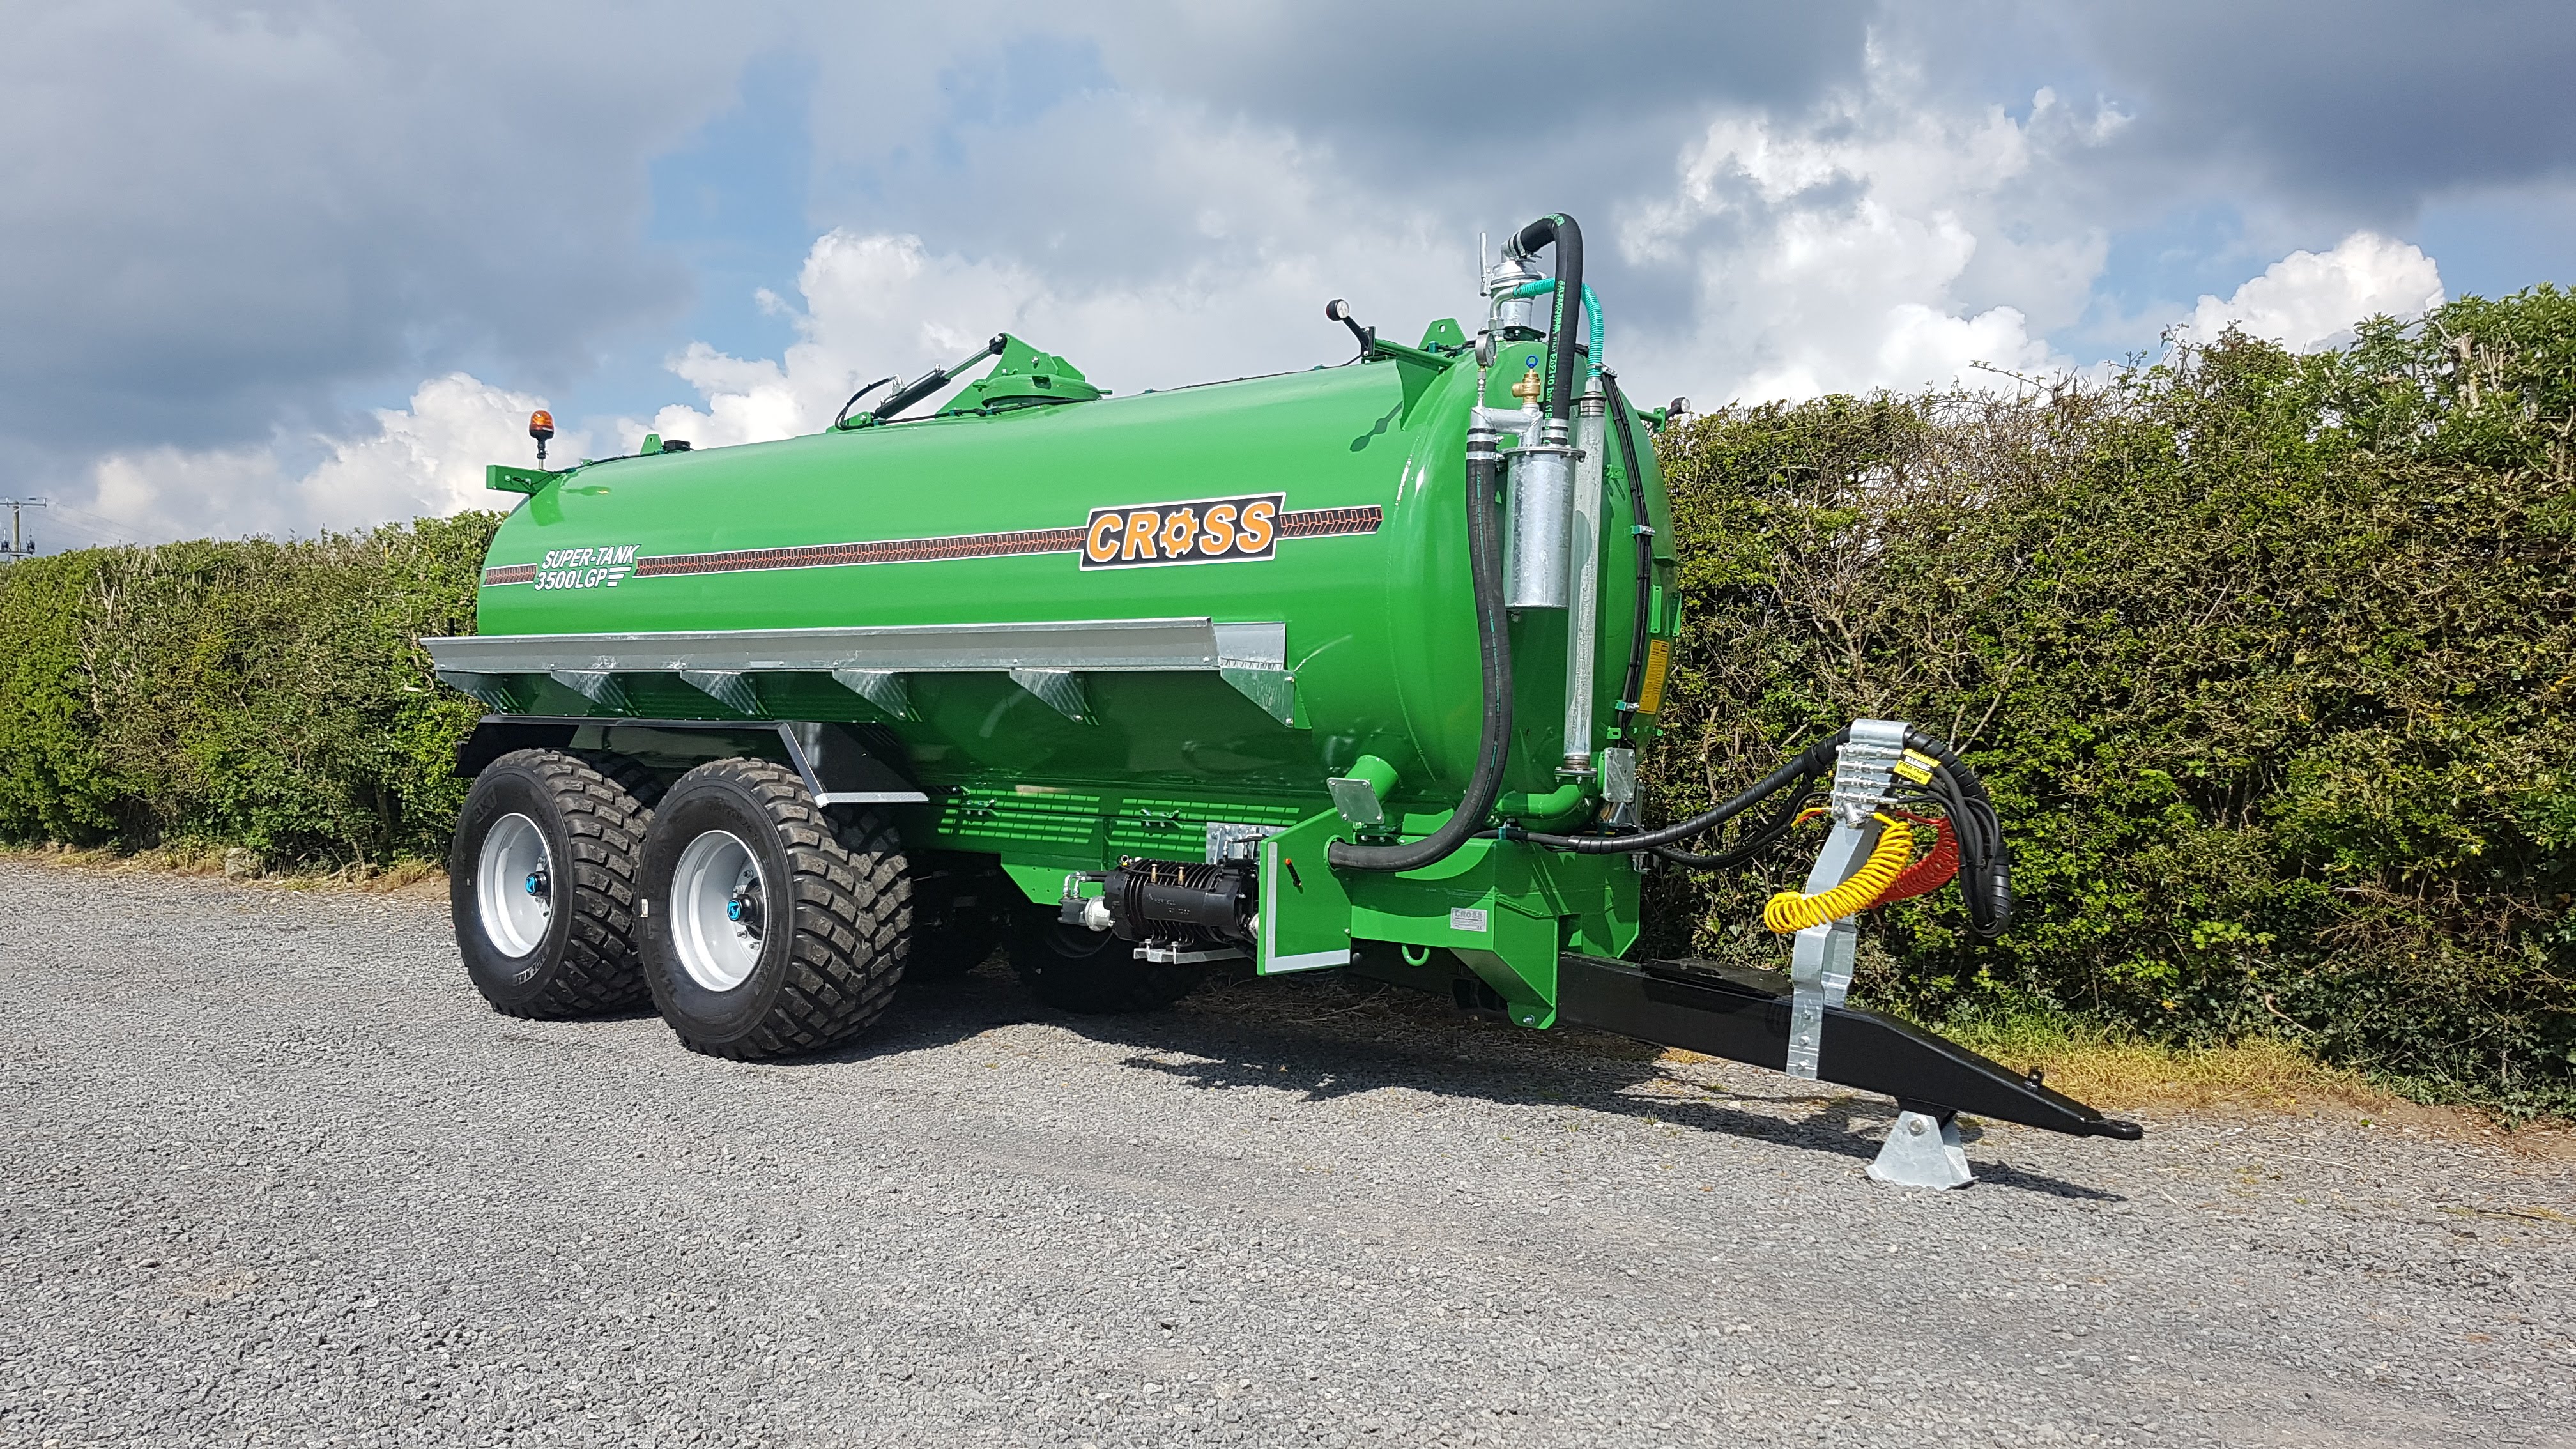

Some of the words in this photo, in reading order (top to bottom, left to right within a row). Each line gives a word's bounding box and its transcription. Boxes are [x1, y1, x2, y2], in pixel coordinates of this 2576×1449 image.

[1547, 374, 1555, 385] 10
[1087, 501, 1276, 562] CROSS
[542, 544, 641, 569] SUPER-TANK
[535, 567, 608, 590] 3500LGP
[1899, 762, 1913, 770] FREE
[1914, 768, 1929, 777] FLOW
[1905, 756, 1931, 771] WARNING
[1900, 769, 1922, 781] RETURN
[1455, 910, 1483, 919] CROSS
